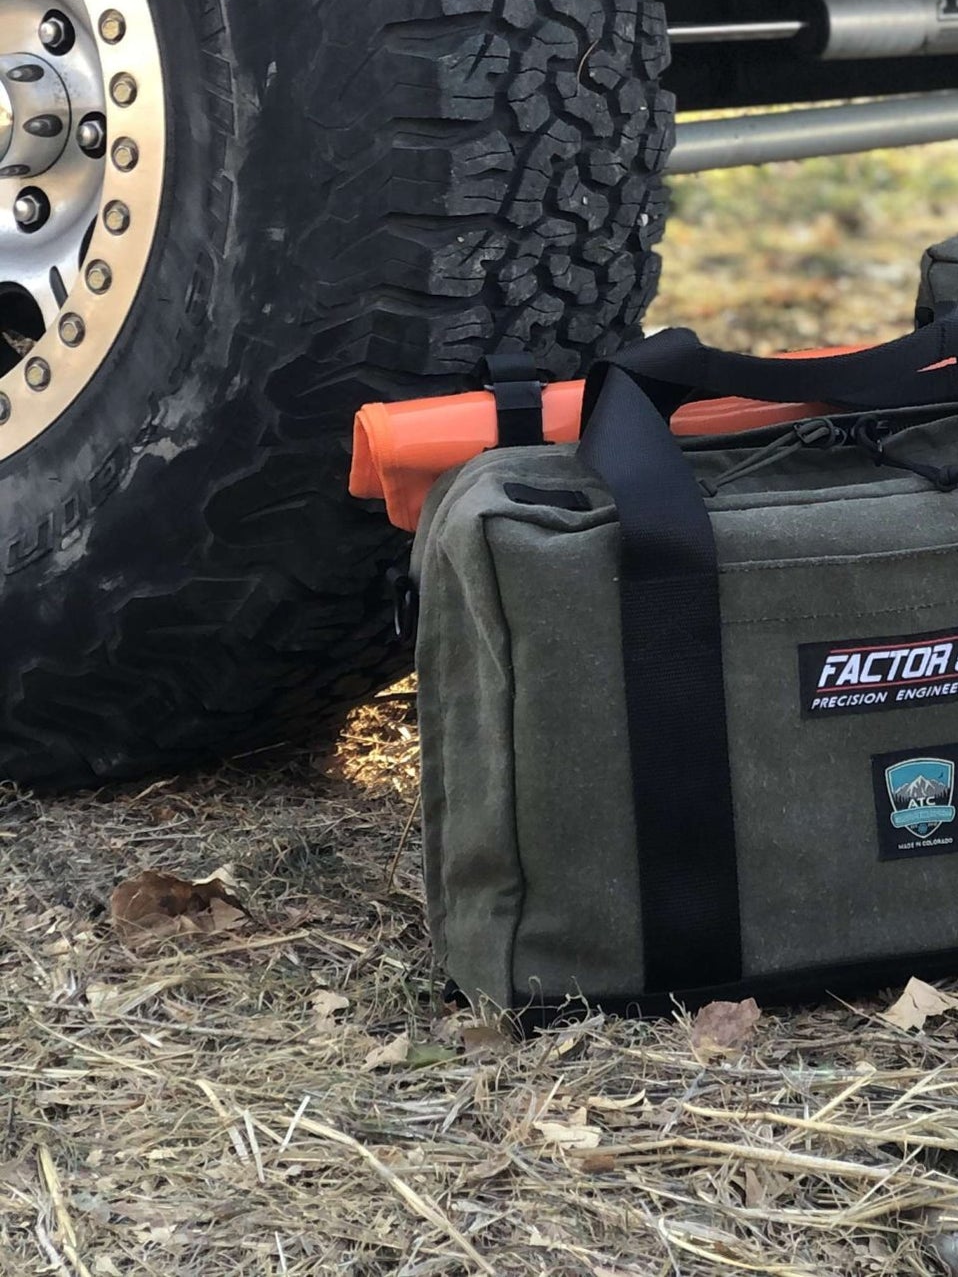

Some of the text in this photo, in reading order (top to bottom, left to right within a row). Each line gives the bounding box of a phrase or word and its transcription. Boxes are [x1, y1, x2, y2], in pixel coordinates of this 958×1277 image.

[817, 643, 953, 688] FACTOR
[811, 691, 888, 710] PRECISION
[908, 797, 936, 809] ATC
[923, 838, 953, 846] COLORADO
